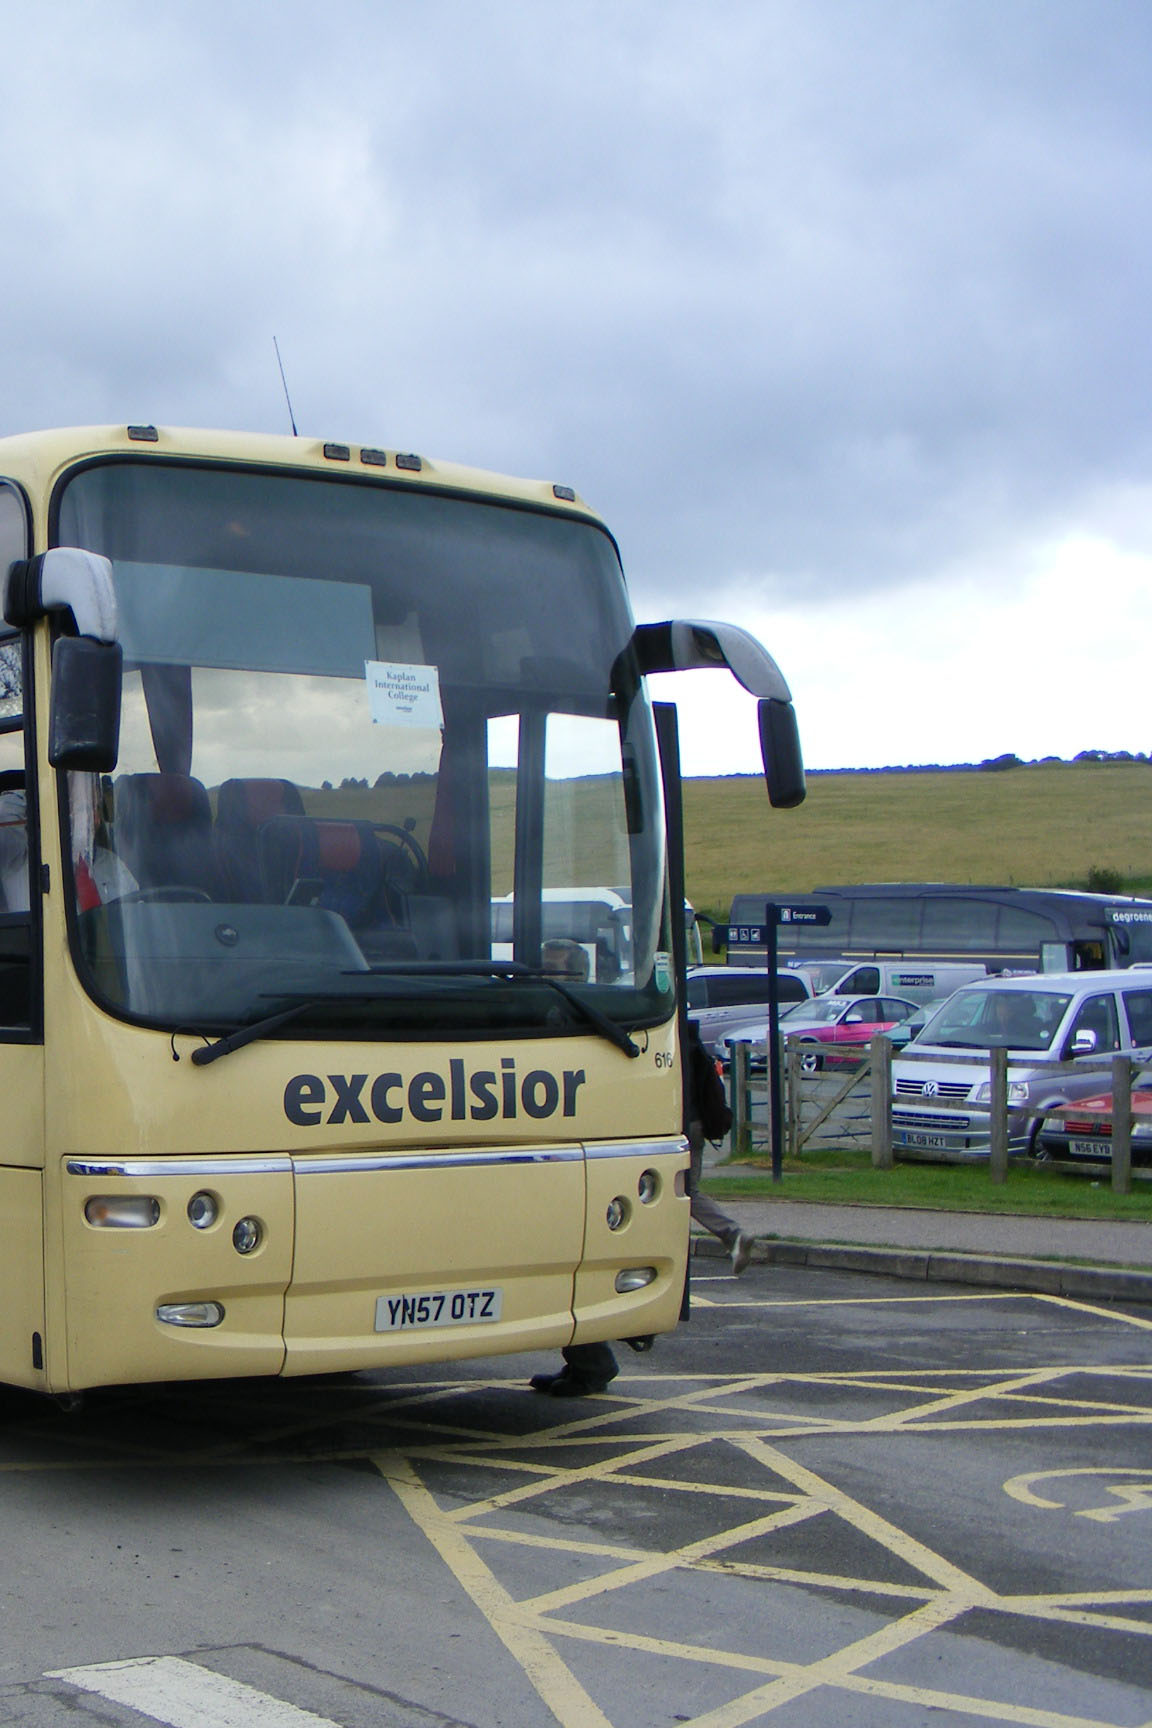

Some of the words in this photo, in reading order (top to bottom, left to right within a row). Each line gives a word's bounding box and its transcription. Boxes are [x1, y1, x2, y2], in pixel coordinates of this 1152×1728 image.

[386, 671, 416, 682] Kaplan
[374, 680, 430, 692] International
[388, 690, 419, 703] College
[792, 911, 817, 920] Entrance
[892, 975, 934, 985] enterprise
[654, 1052, 673, 1068] 616
[283, 1057, 587, 1126] excelsior
[388, 1295, 446, 1326] YN57
[451, 1291, 495, 1320] OTZ
